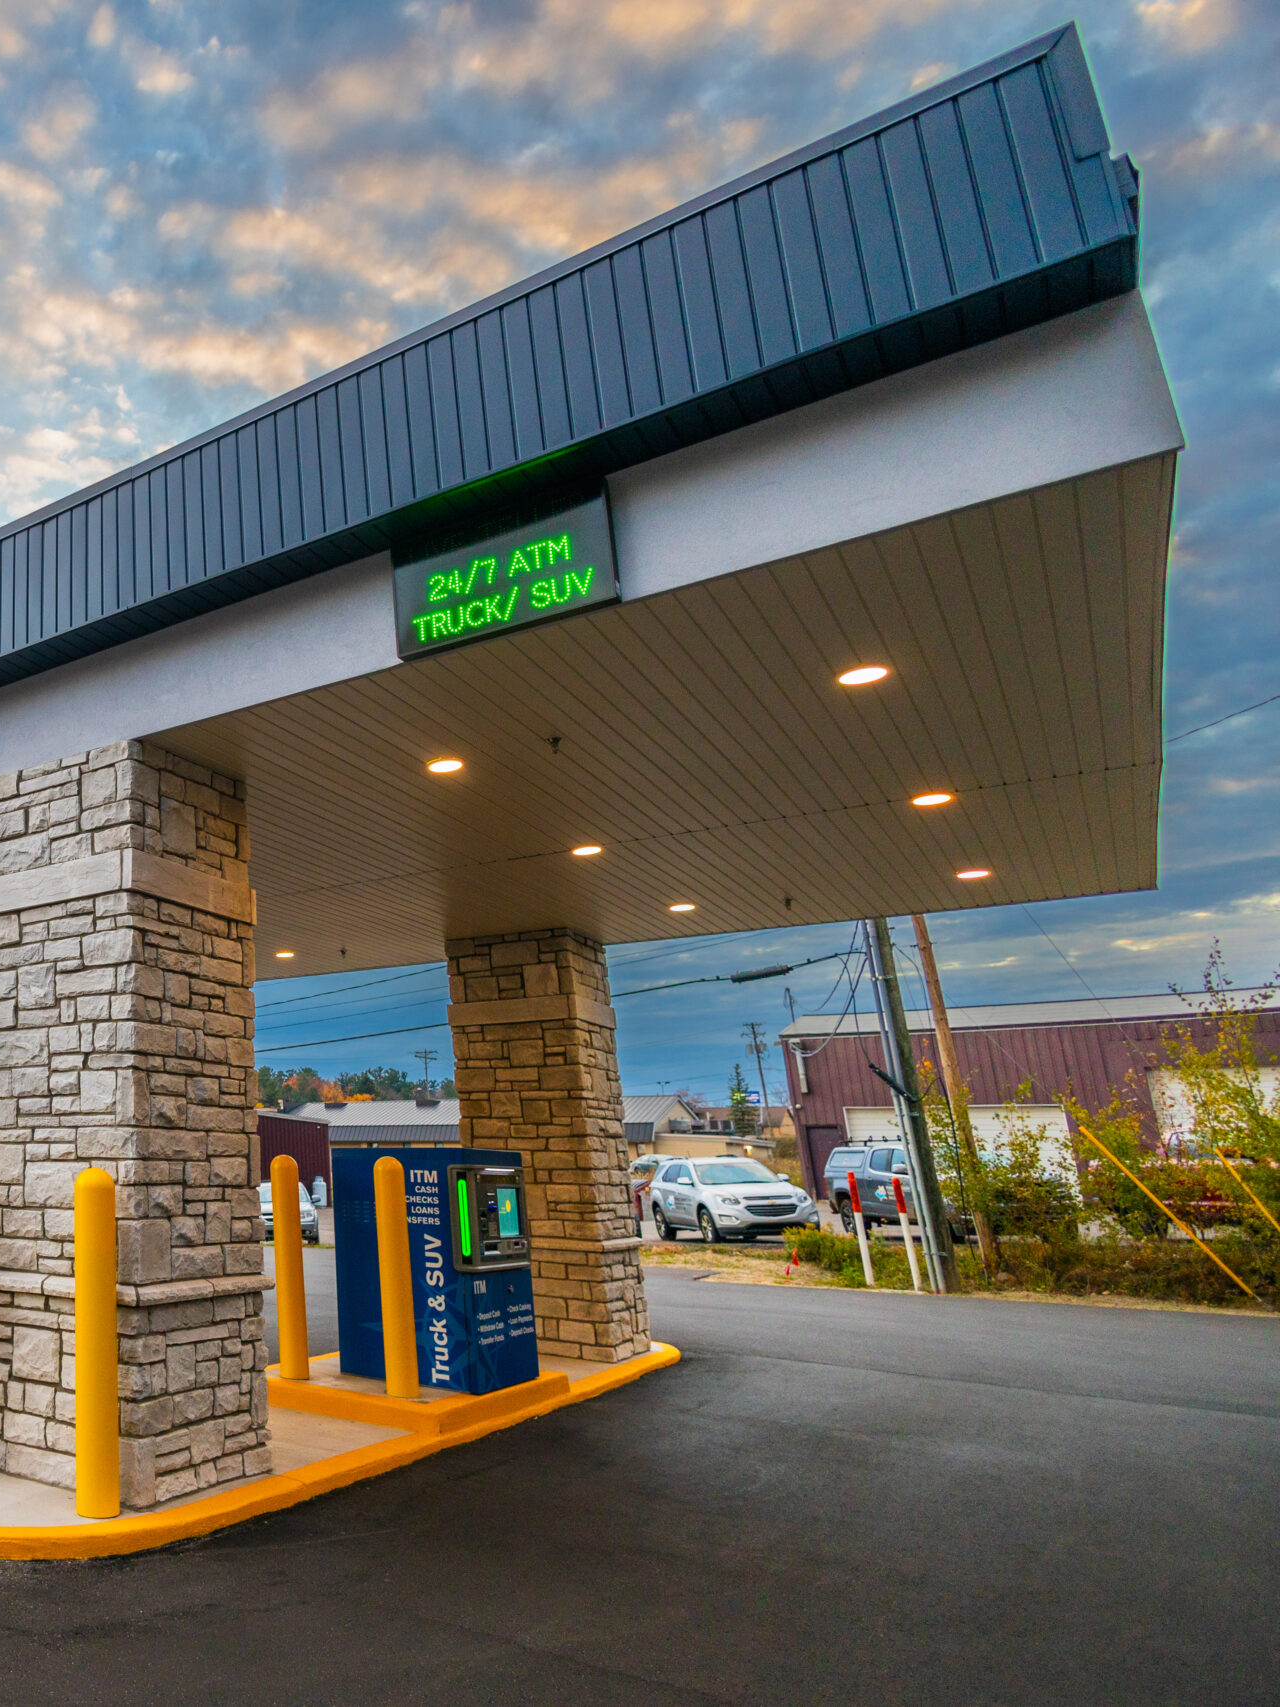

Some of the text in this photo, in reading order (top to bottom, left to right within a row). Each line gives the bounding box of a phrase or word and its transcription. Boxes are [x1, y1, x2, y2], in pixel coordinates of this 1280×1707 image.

[428, 534, 571, 602] 24/7 ATM
[412, 566, 595, 642] TRUCK/ SUV
[410, 1169, 439, 1184] ITM
[414, 1185, 439, 1194] CASH
[405, 1195, 440, 1205] CHECKS
[411, 1205, 440, 1215] LOANS
[406, 1216, 441, 1226] NSFERS
[473, 1279, 487, 1295] ITM
[423, 1233, 451, 1384] Truck & SUV
